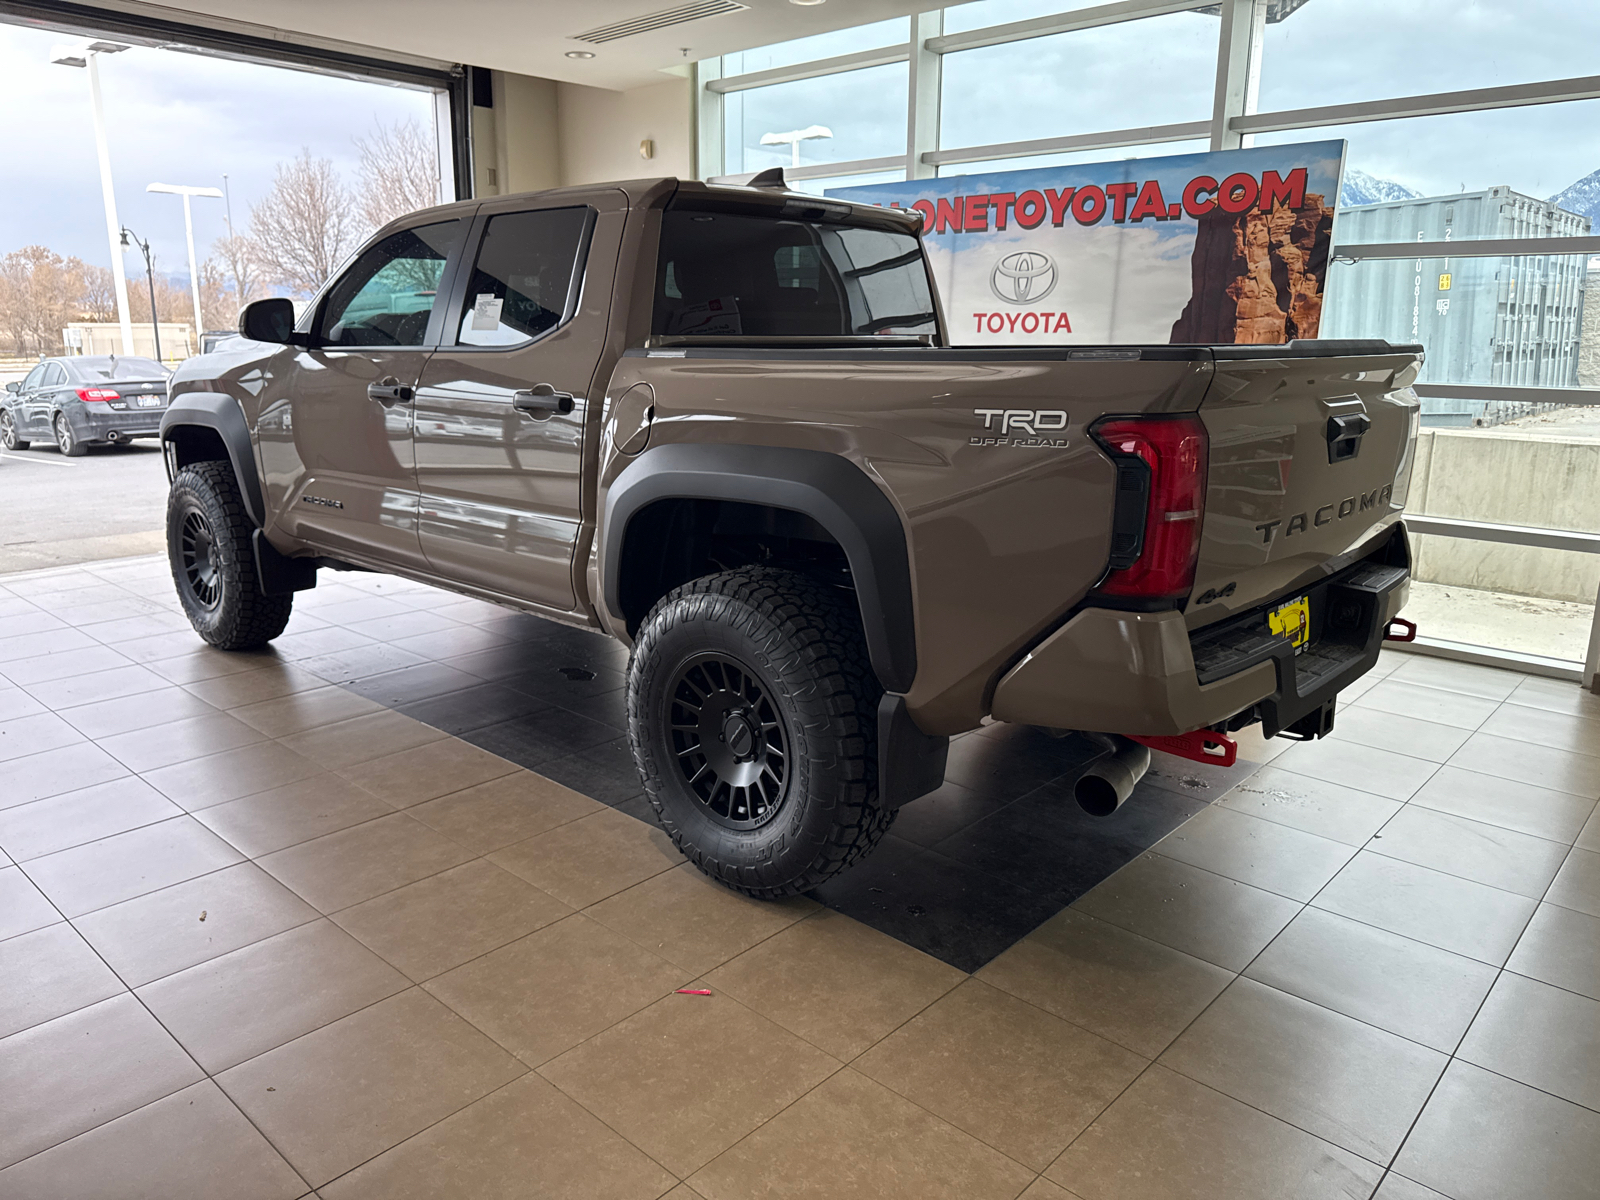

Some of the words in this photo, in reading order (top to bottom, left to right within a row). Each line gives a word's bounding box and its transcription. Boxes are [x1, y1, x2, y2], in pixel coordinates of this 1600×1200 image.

[873, 167, 1308, 234] ONETOYOTA.COM
[973, 312, 1072, 334] TOYOTA
[974, 408, 1068, 435] TRD
[968, 437, 1009, 447] OFF
[1011, 438, 1070, 449] ROAD
[1255, 483, 1393, 544] TACOMA
